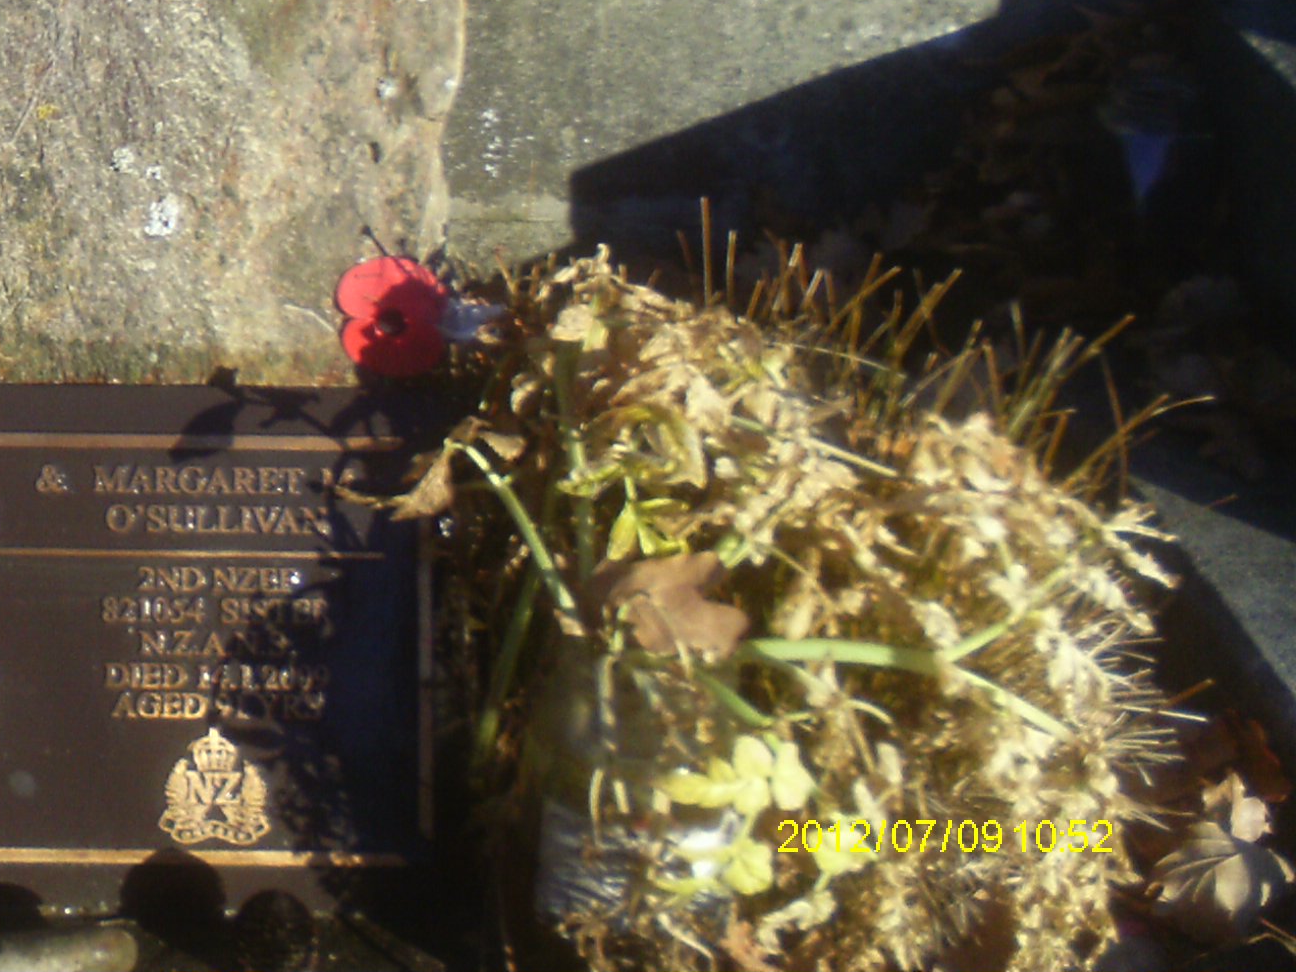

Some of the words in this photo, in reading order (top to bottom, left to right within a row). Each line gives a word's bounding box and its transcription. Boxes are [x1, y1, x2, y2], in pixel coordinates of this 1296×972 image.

[34, 464, 67, 493] &
[93, 465, 305, 495] MARGARET
[105, 503, 333, 535] O'SULLIVAN
[137, 566, 206, 592] 2ND
[211, 566, 302, 594] NZEF
[101, 596, 206, 624] 821054
[220, 597, 329, 625] SISTER
[104, 662, 188, 689] DIED
[111, 692, 208, 720] AGED
[185, 770, 242, 804] NZ
